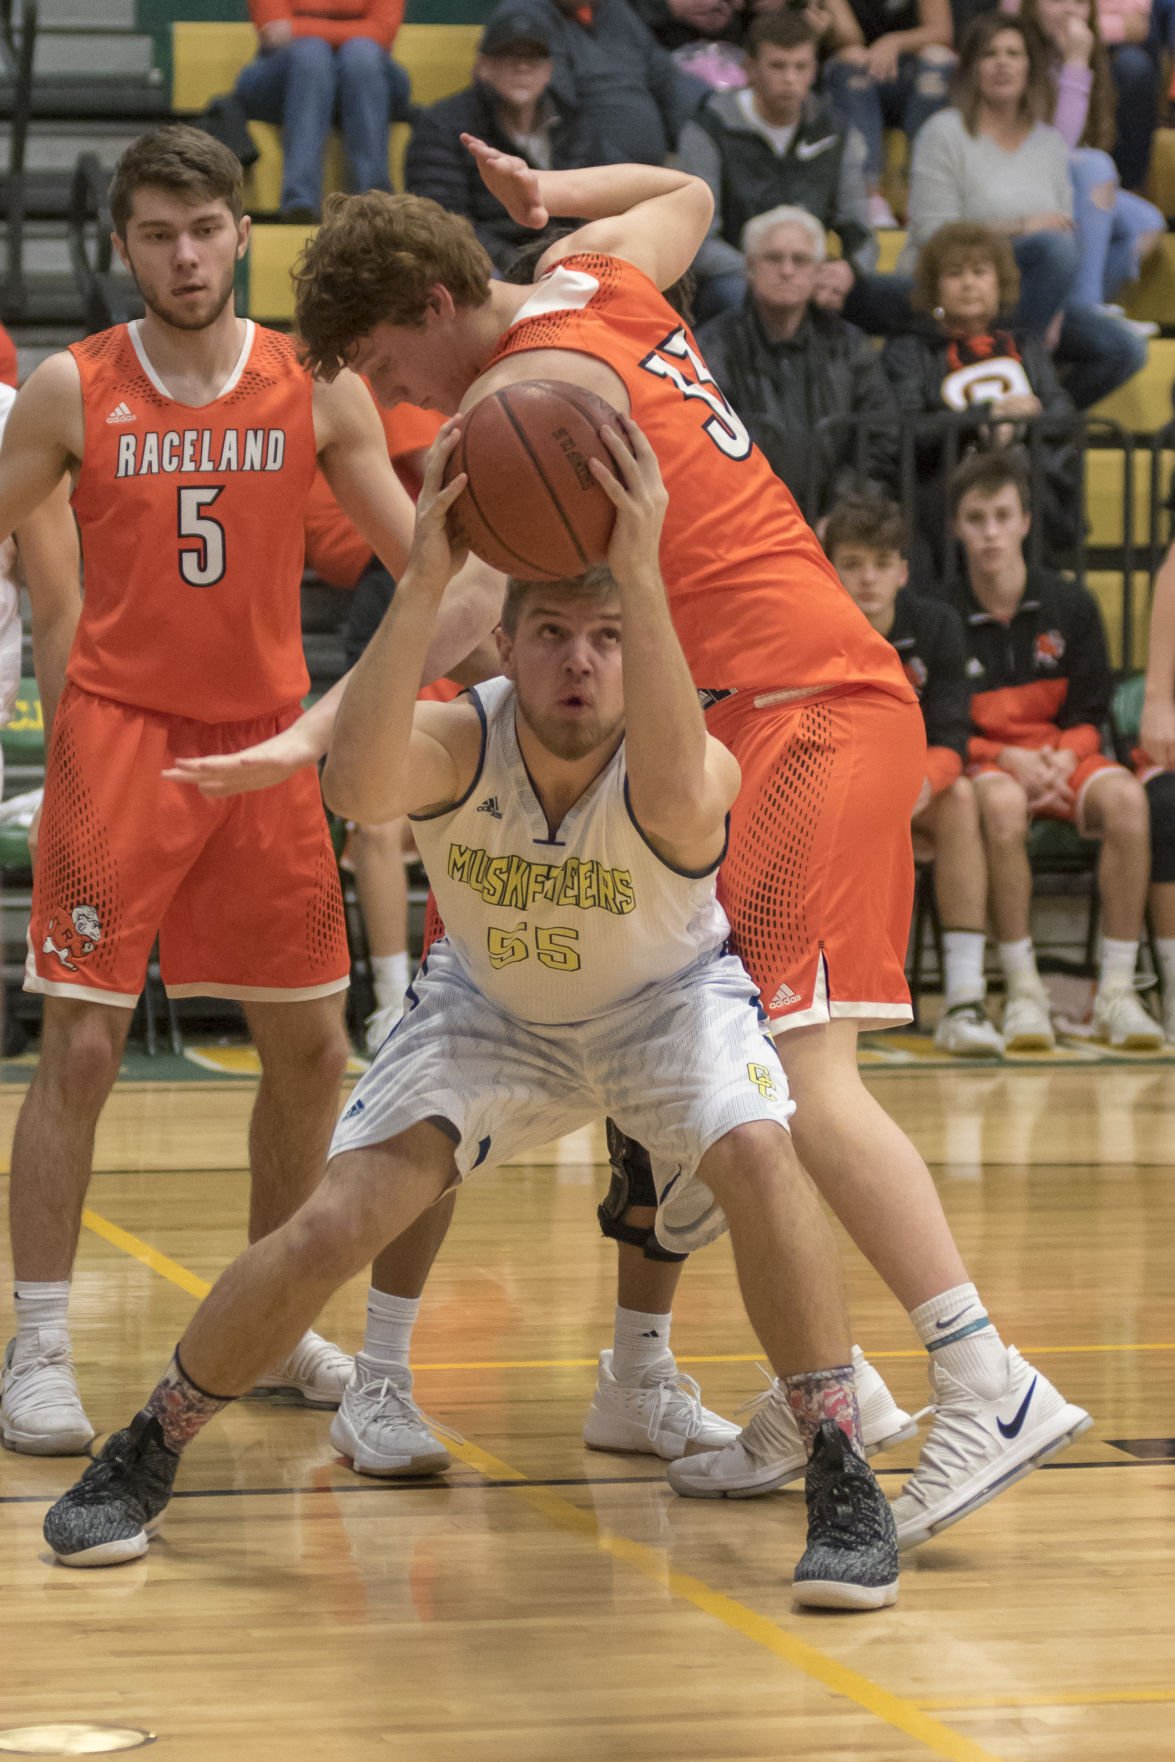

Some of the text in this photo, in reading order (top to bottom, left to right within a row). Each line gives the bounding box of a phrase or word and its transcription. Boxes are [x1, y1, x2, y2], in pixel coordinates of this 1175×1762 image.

[115, 428, 286, 479] RACELAND
[177, 485, 226, 588] 5
[487, 922, 581, 972] 55
[769, 994, 802, 1009] adidas
